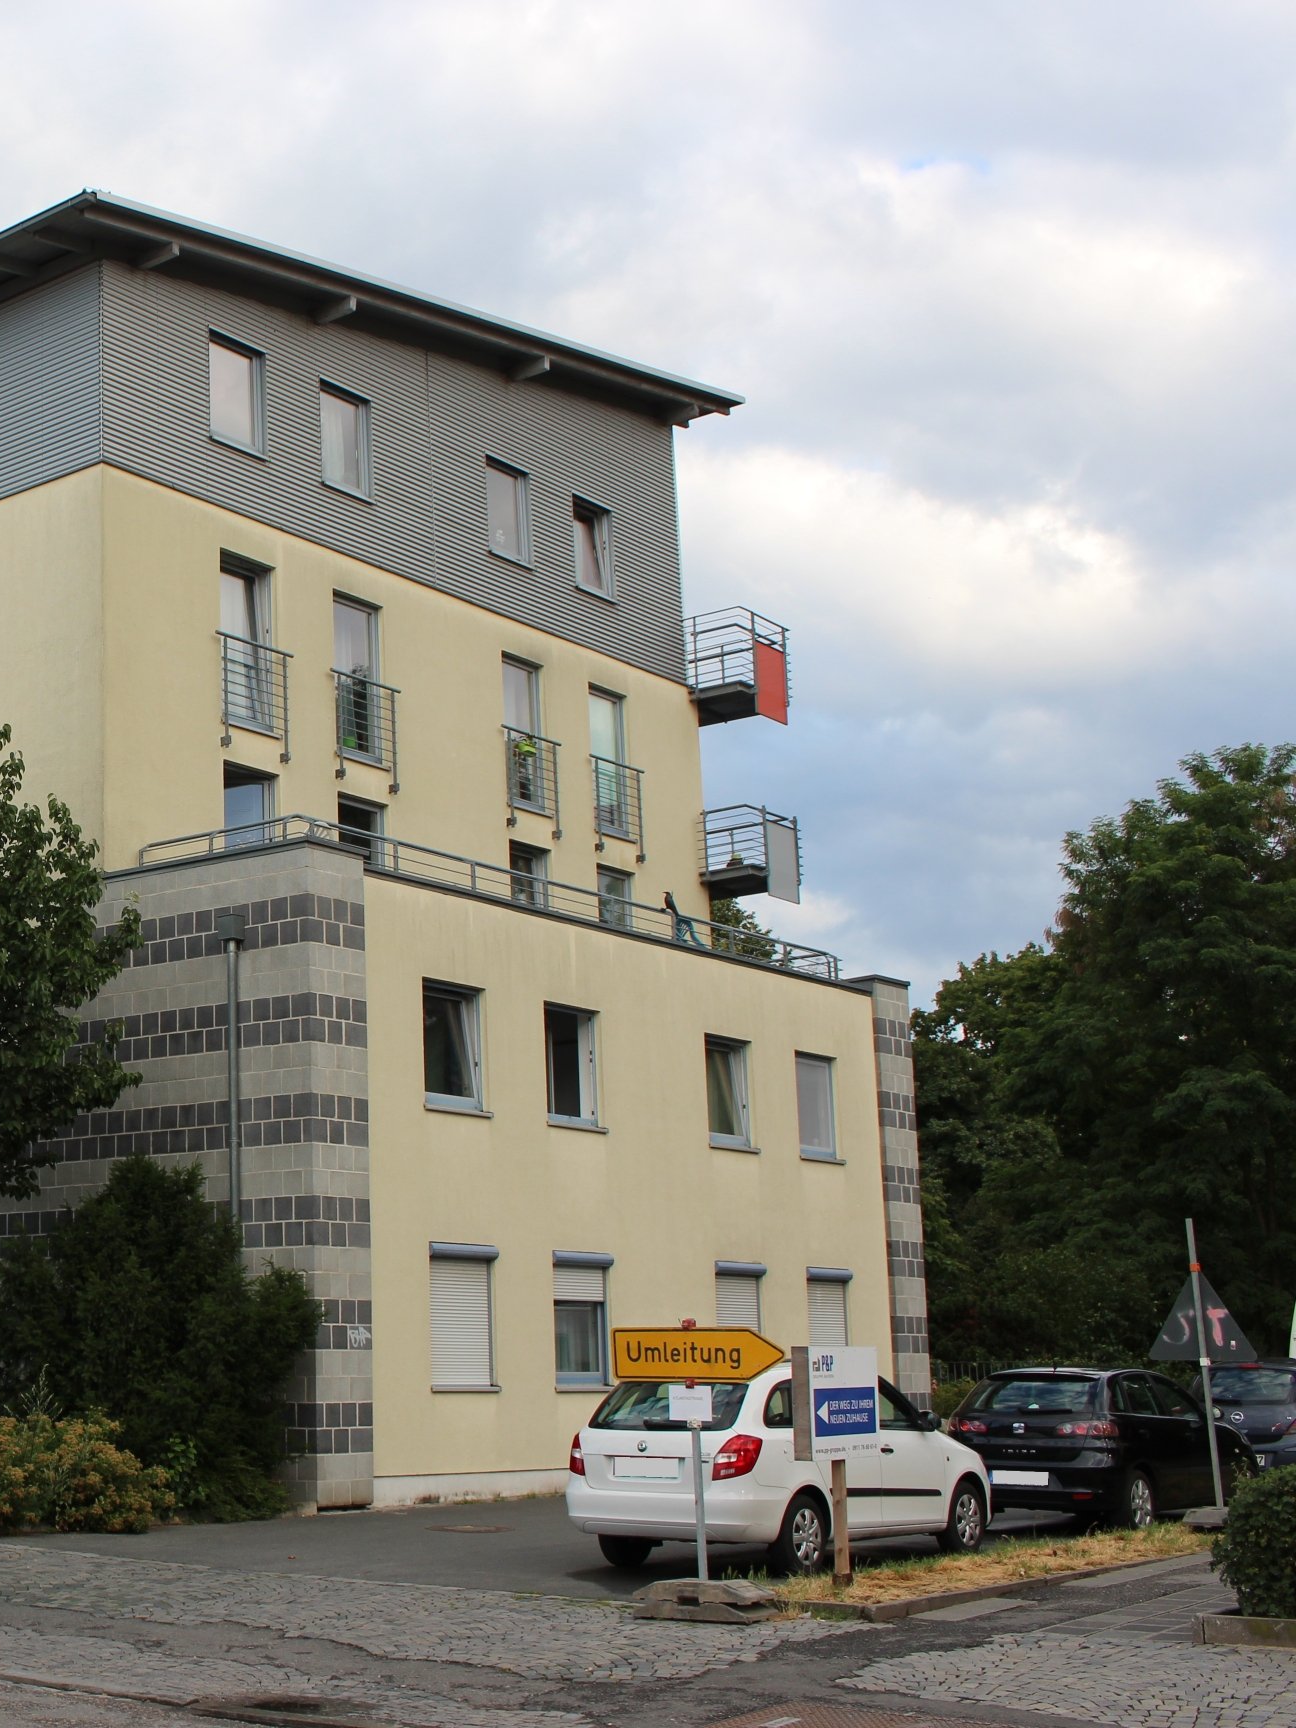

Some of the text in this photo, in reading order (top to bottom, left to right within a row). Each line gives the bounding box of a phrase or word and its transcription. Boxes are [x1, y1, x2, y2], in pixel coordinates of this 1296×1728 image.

[626, 1341, 742, 1369] Umleitung
[821, 1354, 834, 1372] P&P
[829, 1399, 874, 1411] DER WEG ZU IHREM
[829, 1412, 869, 1424] NEUEN ZUHAUSE
